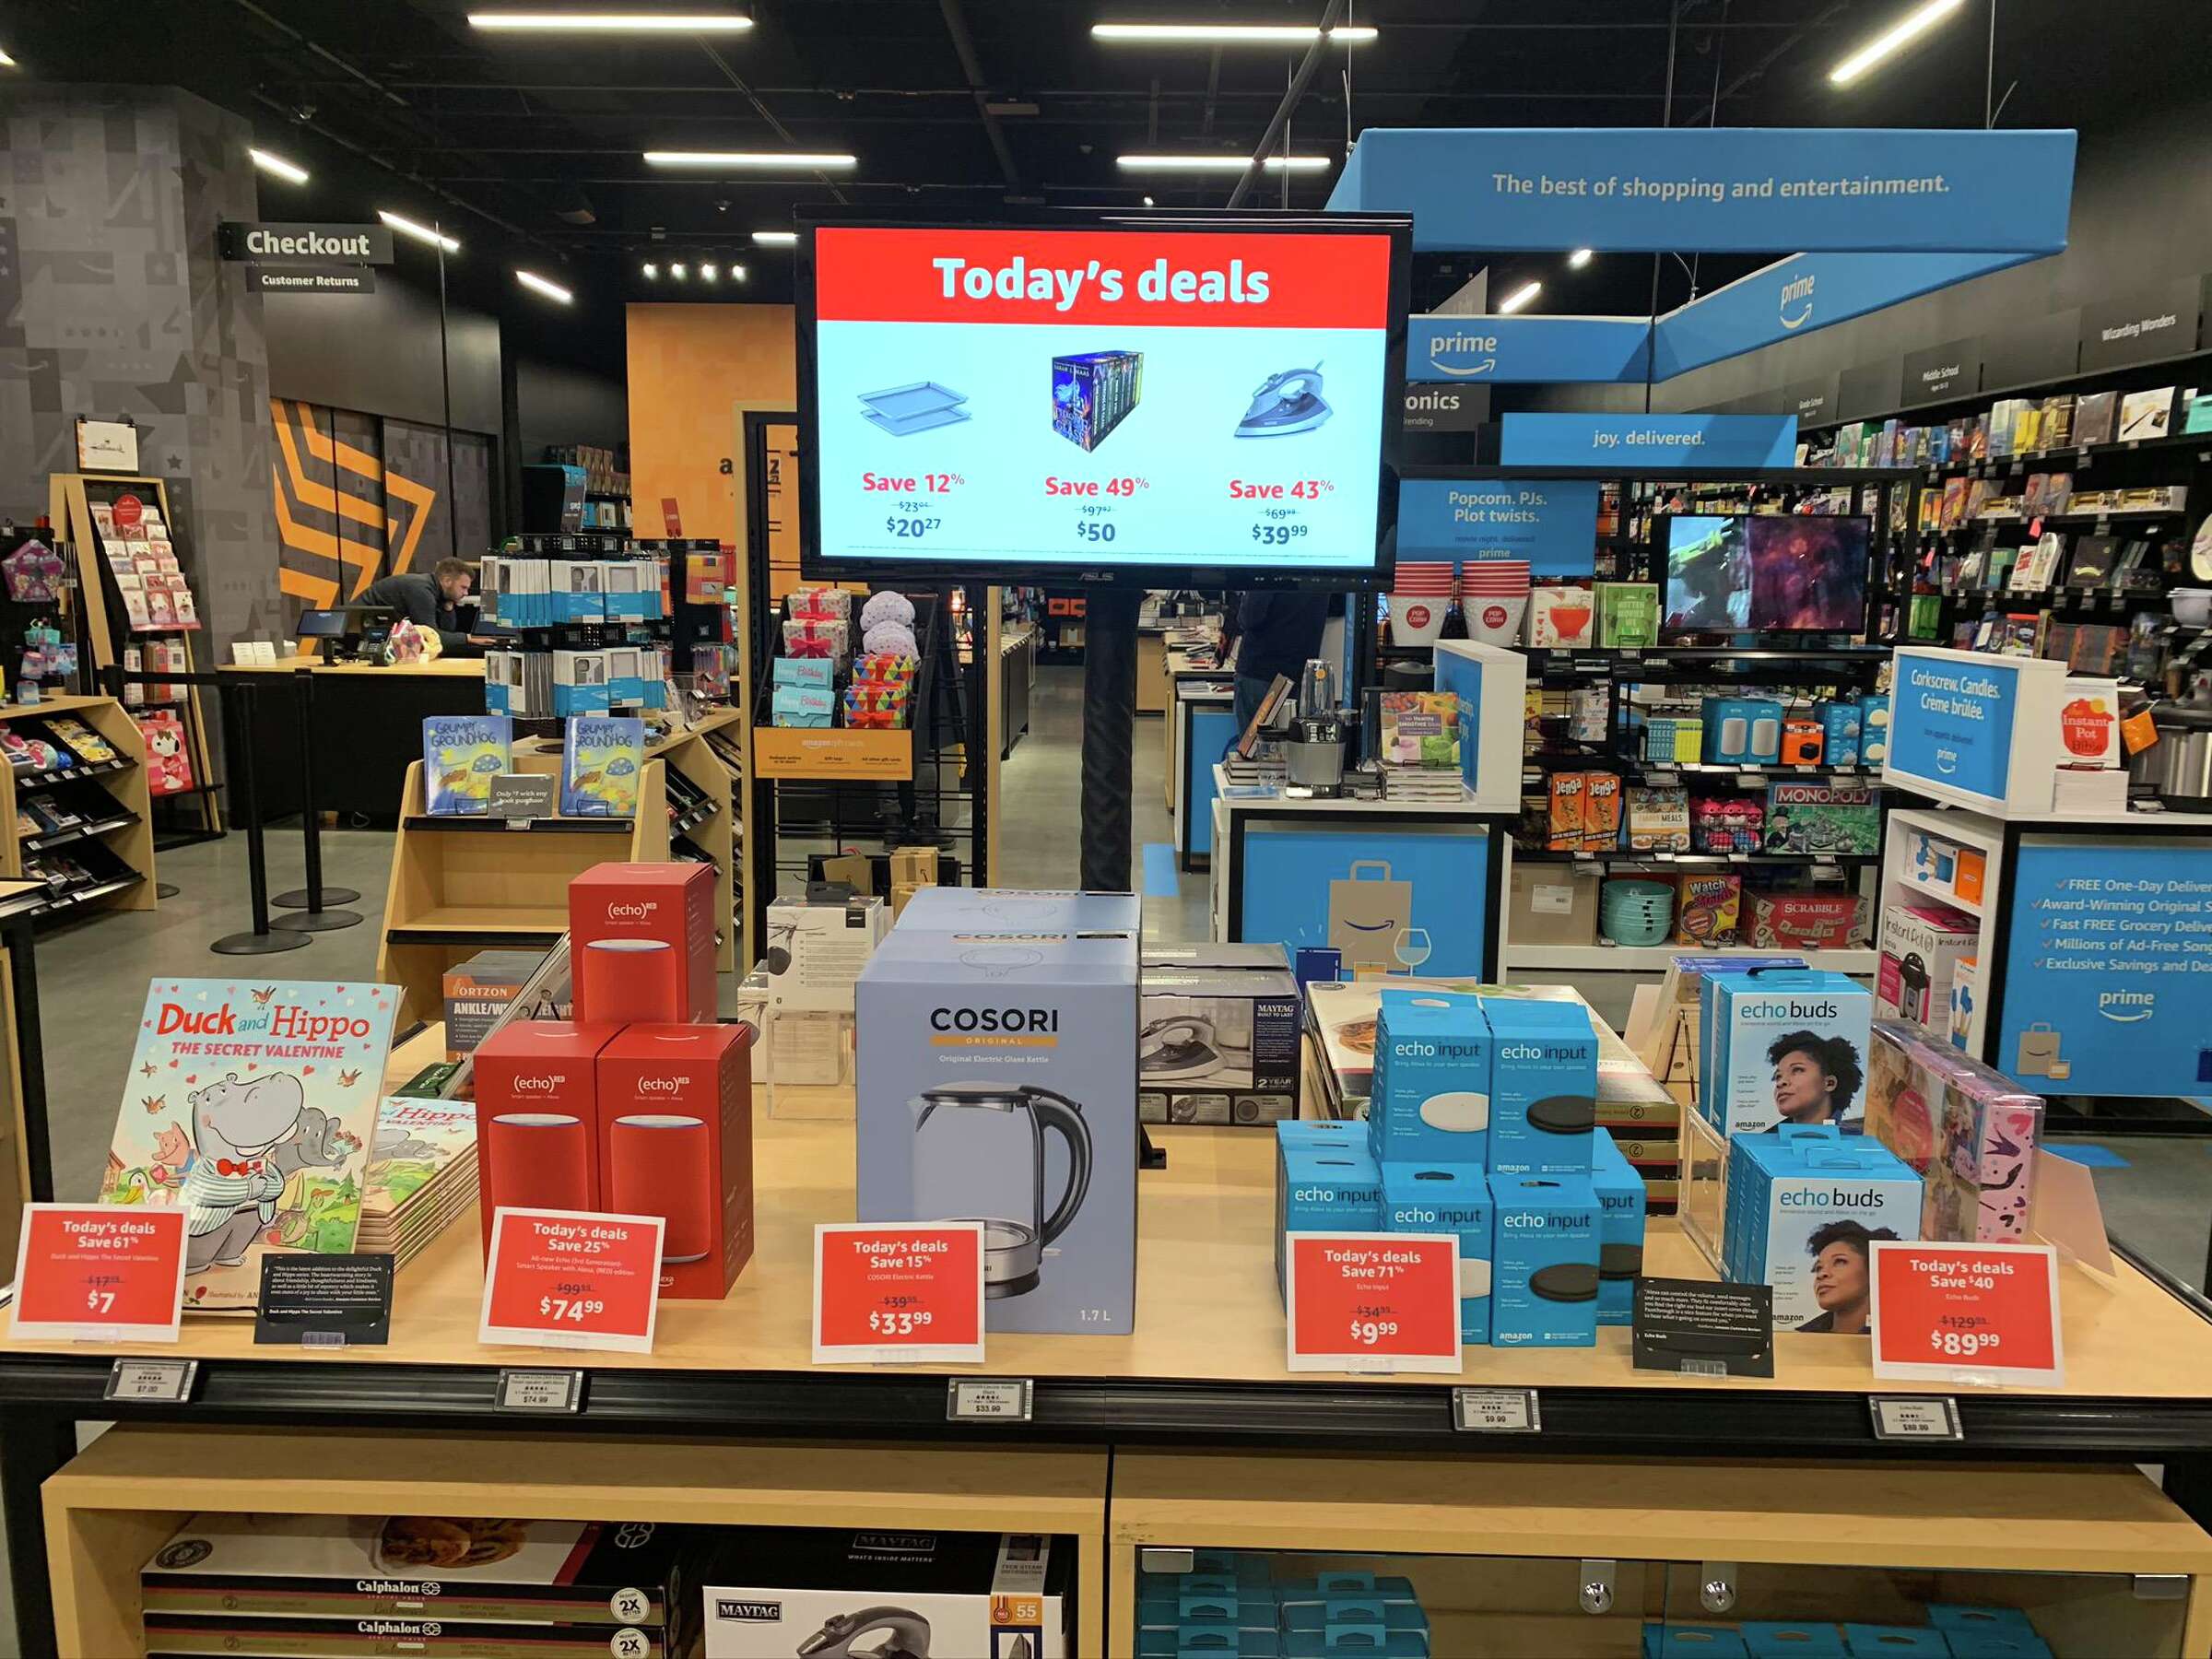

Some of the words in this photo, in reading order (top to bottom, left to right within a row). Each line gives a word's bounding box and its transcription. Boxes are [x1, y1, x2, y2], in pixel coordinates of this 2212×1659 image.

[1493, 173, 1534, 194] The
[1540, 175, 1588, 195] best
[1593, 176, 1618, 196] of
[1622, 177, 1724, 203] shopping
[1731, 178, 1773, 197] and
[1780, 174, 1950, 196] entertainment.
[246, 230, 371, 255] Checkout
[262, 275, 314, 288] Customer
[316, 276, 359, 288] Returns
[933, 256, 1124, 312] Today's
[1137, 259, 1270, 304] deals
[1781, 274, 1815, 310] prime
[2102, 323, 2140, 343] Wizarding
[2141, 313, 2176, 334] Wonders
[1430, 332, 1497, 358] prime
[1940, 365, 1959, 380] School
[1406, 391, 1460, 410] onics
[1592, 430, 1621, 450] joy.
[1626, 429, 1705, 447] delivered.
[863, 472, 916, 491] Save
[925, 474, 965, 492] 12%
[1045, 477, 1099, 496] Save
[1106, 477, 1149, 496] 49%
[1230, 479, 1283, 499] Save
[1290, 480, 1334, 500] 43%
[1449, 491, 1516, 508] Popcorn.
[1520, 491, 1547, 506] PJs.
[1454, 509, 1485, 523] Plot
[1489, 509, 1539, 523] twists.
[1077, 521, 1115, 542] $50
[1478, 547, 1511, 559] prime
[1077, 572, 1115, 582] ASUS
[1911, 669, 1959, 691] Corkscrew.
[1960, 677, 2001, 699] Candles.
[1921, 693, 1949, 714] Crème
[1951, 698, 1984, 721] brûlée.
[2063, 715, 2108, 726] Instant
[435, 722, 477, 735] GRUMPY
[577, 722, 615, 735] GRUMPY
[2076, 728, 2097, 739] Pot
[431, 732, 497, 747] GROUNDHOG
[575, 734, 633, 747] GROUNDHOG
[1936, 747, 1958, 763] prime
[1556, 778, 1582, 795] Jenga
[1589, 780, 1617, 798] Jenga
[1778, 785, 1871, 805] MONOPOLY
[1661, 814, 1683, 823] MEALS
[1689, 878, 1726, 894] Watch
[2069, 879, 2101, 891] FREE
[2105, 879, 2163, 894] One-Day
[2167, 881, 2212, 892] Deliver
[1784, 903, 1843, 914] SCRABBLE
[2042, 899, 2145, 914] Award-Winning
[2148, 900, 2201, 915] Original
[2053, 918, 2080, 930] Fast
[2083, 920, 2116, 931] FREE
[2120, 920, 2171, 935] Grocery
[2055, 938, 2106, 950] Millions
[2110, 938, 2124, 950] of
[2126, 940, 2179, 951] Ad-Free
[2046, 958, 2106, 970] Exclusive
[2109, 959, 2159, 973] Savings
[2162, 960, 2188, 972] and
[2100, 989, 2154, 1007] prime
[453, 1002, 508, 1016] ANKLE/W
[1257, 1005, 1294, 1013] MAYTAG
[1740, 1001, 1786, 1018] echo
[1790, 1001, 1838, 1018] buds
[157, 1003, 237, 1035] Duck
[238, 1012, 270, 1032] and
[270, 1005, 370, 1041] Hippo
[930, 1007, 1058, 1032] COSORI
[966, 1037, 1023, 1045] ORIGINAL
[171, 1041, 200, 1055] THE
[204, 1042, 262, 1056] SECRET
[265, 1043, 346, 1059] VALENTINE
[1395, 1041, 1435, 1056] echo
[1438, 1041, 1481, 1060] input
[1501, 1044, 1541, 1060] echo
[1544, 1044, 1587, 1062] input
[939, 1054, 971, 1064] Original
[973, 1054, 1003, 1063] Electric
[1257, 1078, 1268, 1088] 2
[1735, 1121, 1766, 1129] amazon
[1497, 1163, 1530, 1173] amazon
[1295, 1187, 1335, 1203] echo
[1336, 1187, 1380, 1205] input
[1599, 1194, 1634, 1210] nput
[1780, 1187, 1830, 1206] echo
[1832, 1188, 1884, 1207] buds
[1394, 1207, 1435, 1224] echo
[1438, 1208, 1481, 1227] input
[1504, 1211, 1545, 1229] echo
[1547, 1212, 1591, 1230] input
[63, 1220, 116, 1237] Today's
[120, 1221, 156, 1234] deals
[533, 1223, 587, 1239] Today's
[591, 1226, 628, 1241] deals
[77, 1235, 112, 1248] Save
[113, 1236, 138, 1248] 61%
[548, 1239, 582, 1253] Save
[584, 1241, 610, 1253] 25%
[853, 1241, 908, 1255] Today's
[912, 1240, 948, 1253] deals
[870, 1256, 903, 1268] Save
[906, 1255, 932, 1268] 15%
[1324, 1250, 1379, 1265] Today's
[1382, 1251, 1421, 1264] deals
[1341, 1265, 1375, 1278] Save
[1378, 1265, 1405, 1278] 71%
[1910, 1259, 1969, 1276] Today's
[1972, 1261, 2014, 1275] deals
[1930, 1275, 1967, 1288] Save
[1969, 1276, 1994, 1289] $40
[88, 1290, 115, 1313] $7
[1080, 1309, 1100, 1321] 1.7
[1102, 1310, 1112, 1321] L
[1499, 1332, 1533, 1342] amazon
[975, 1405, 1001, 1413] $33.99
[1485, 1415, 1507, 1423] $9.99
[859, 1535, 933, 1549] MAYTAG
[356, 1580, 419, 1594] Calphalon
[618, 1599, 641, 1612] 2X
[720, 1604, 779, 1618] MAYTAG
[1017, 1605, 1037, 1618] 55
[358, 1621, 420, 1635] Calphalon
[618, 1640, 641, 1653] 2X
